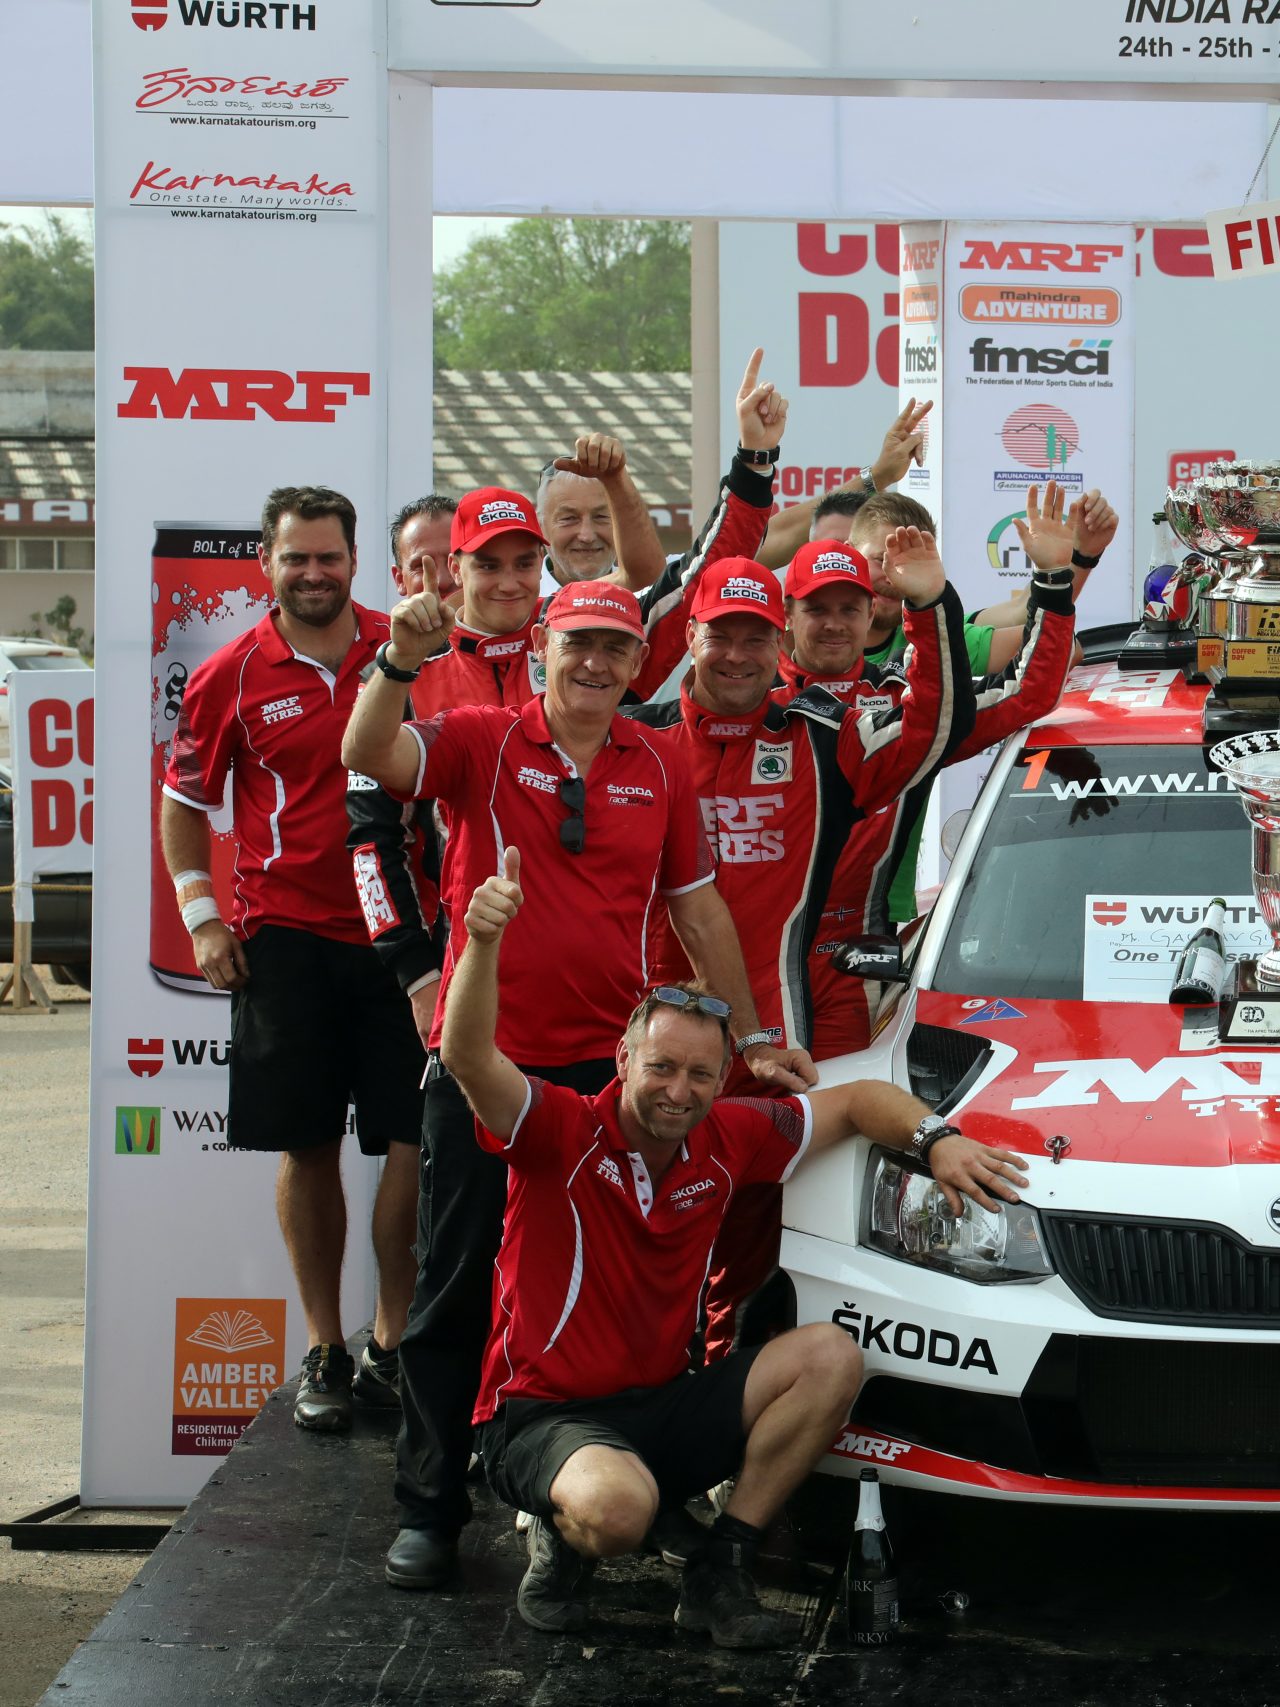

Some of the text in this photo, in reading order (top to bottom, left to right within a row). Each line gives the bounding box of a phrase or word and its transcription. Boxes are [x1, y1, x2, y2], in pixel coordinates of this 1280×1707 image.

[178, 0, 316, 31] WÜRTH
[1125, 0, 1231, 24] INDIA
[1118, 36, 1173, 57] 24th
[1198, 37, 1252, 58] 25th
[170, 115, 316, 129] www.karnatakatourism.org
[130, 161, 356, 199] Karnataka
[150, 192, 348, 208] One state. Many worlds.
[171, 208, 317, 222] www.karnatakatourism.org
[960, 240, 1124, 273] MRF
[1000, 290, 1081, 303] Mahindra
[974, 301, 1108, 320] ADVENTURE
[969, 338, 1110, 376] fmsci
[965, 377, 978, 385] The
[979, 378, 1014, 386] Federation
[1016, 378, 1023, 386] of
[1025, 379, 1044, 387] Motor
[1046, 380, 1067, 389] Sports
[1069, 380, 1087, 388] Clubs
[1089, 380, 1096, 388] of
[117, 366, 370, 423] MRF
[996, 472, 1081, 481] ARUNACHAL PRADESH
[482, 501, 519, 513] MRF
[480, 511, 525, 524] ŠKODA
[193, 540, 226, 554] BOLT
[817, 552, 853, 563] MRF
[814, 562, 857, 575] ŠKODA
[727, 577, 765, 590] MRF
[722, 588, 768, 604] ŠKODA
[484, 640, 526, 657] MRF
[261, 696, 300, 716] MRF
[263, 706, 304, 725] TYRES
[708, 722, 752, 736] MRF
[518, 766, 559, 784] MRF
[1023, 750, 1051, 790] 1
[517, 774, 557, 794] TYRES
[607, 784, 654, 798] ŠKODA
[361, 852, 395, 923] MRF
[848, 953, 898, 969] MRF
[1114, 949, 1160, 962] One
[832, 1301, 999, 1376] ŠKODA
[182, 1362, 277, 1384] AMBER
[177, 1424, 238, 1435] RESIDENTIAL
[834, 1431, 911, 1462] MRF
